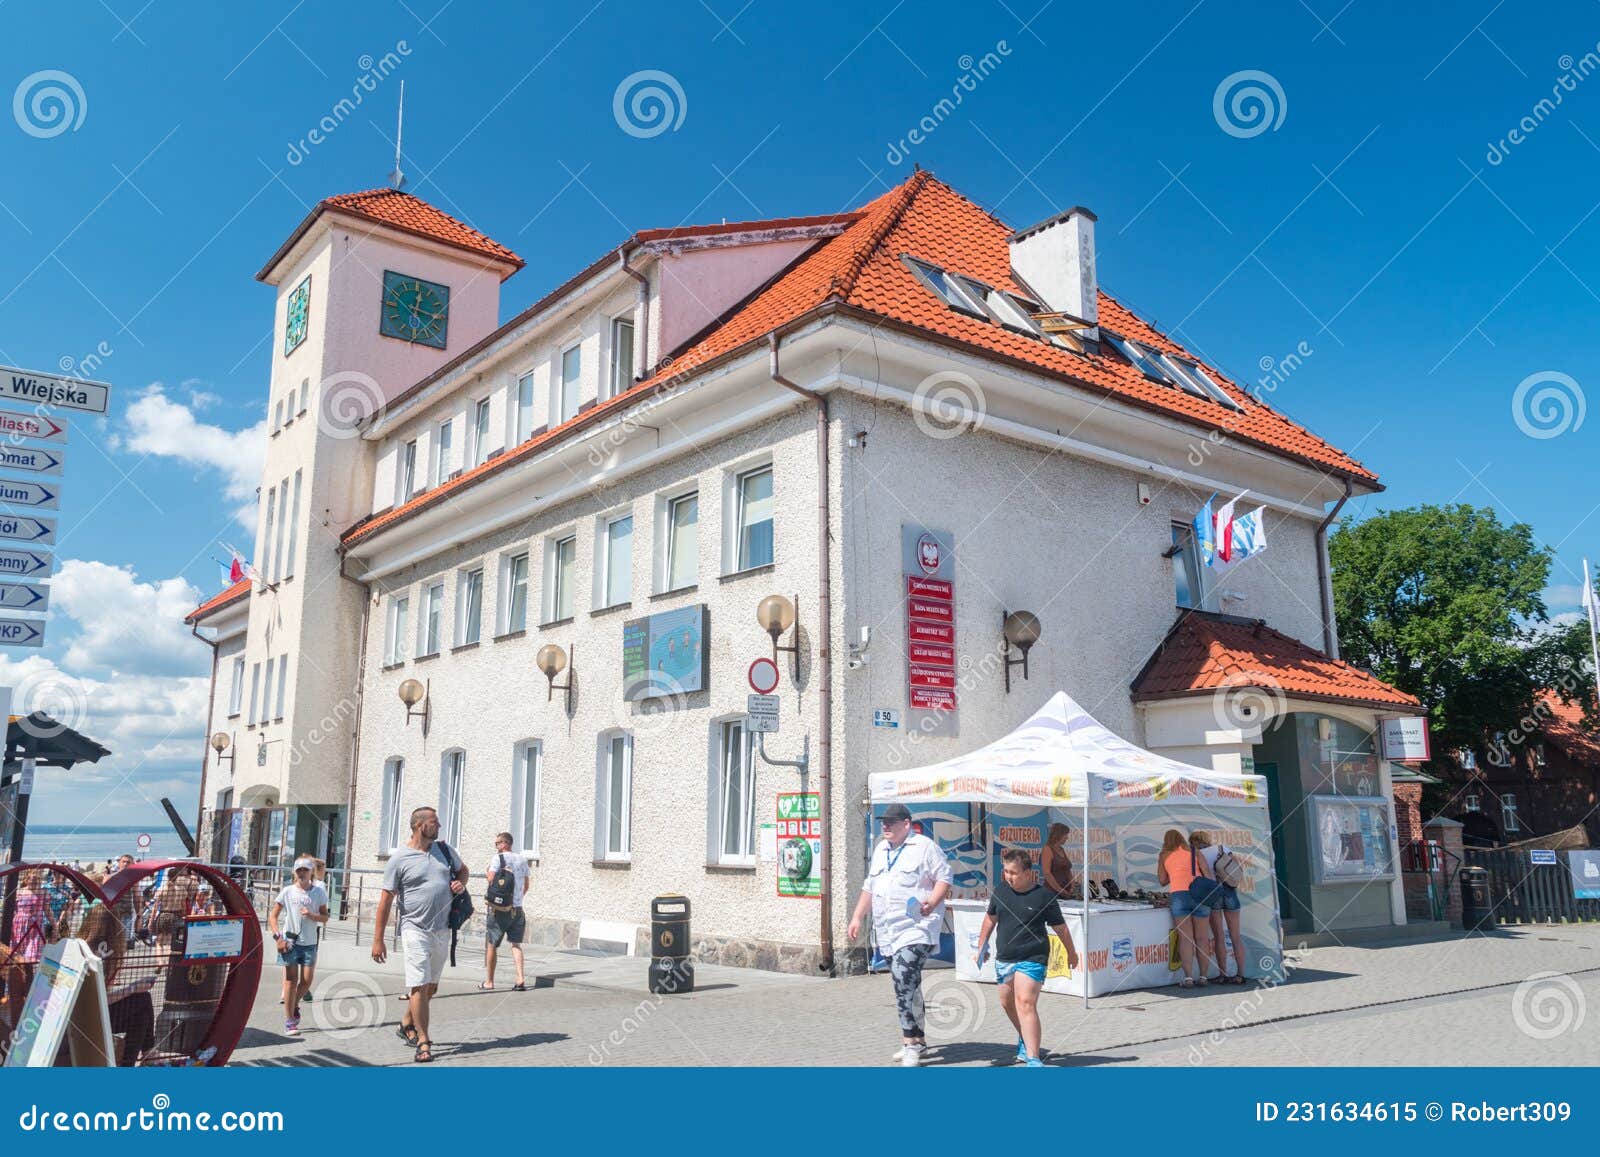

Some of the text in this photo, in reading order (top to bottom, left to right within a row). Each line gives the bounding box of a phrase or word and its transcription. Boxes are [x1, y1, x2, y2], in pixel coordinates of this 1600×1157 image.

[12, 376, 88, 405] Wiejska
[0, 625, 21, 638] KP
[882, 711, 891, 721] 50
[797, 797, 820, 811] AED
[1134, 943, 1169, 965] KAMIENIE
